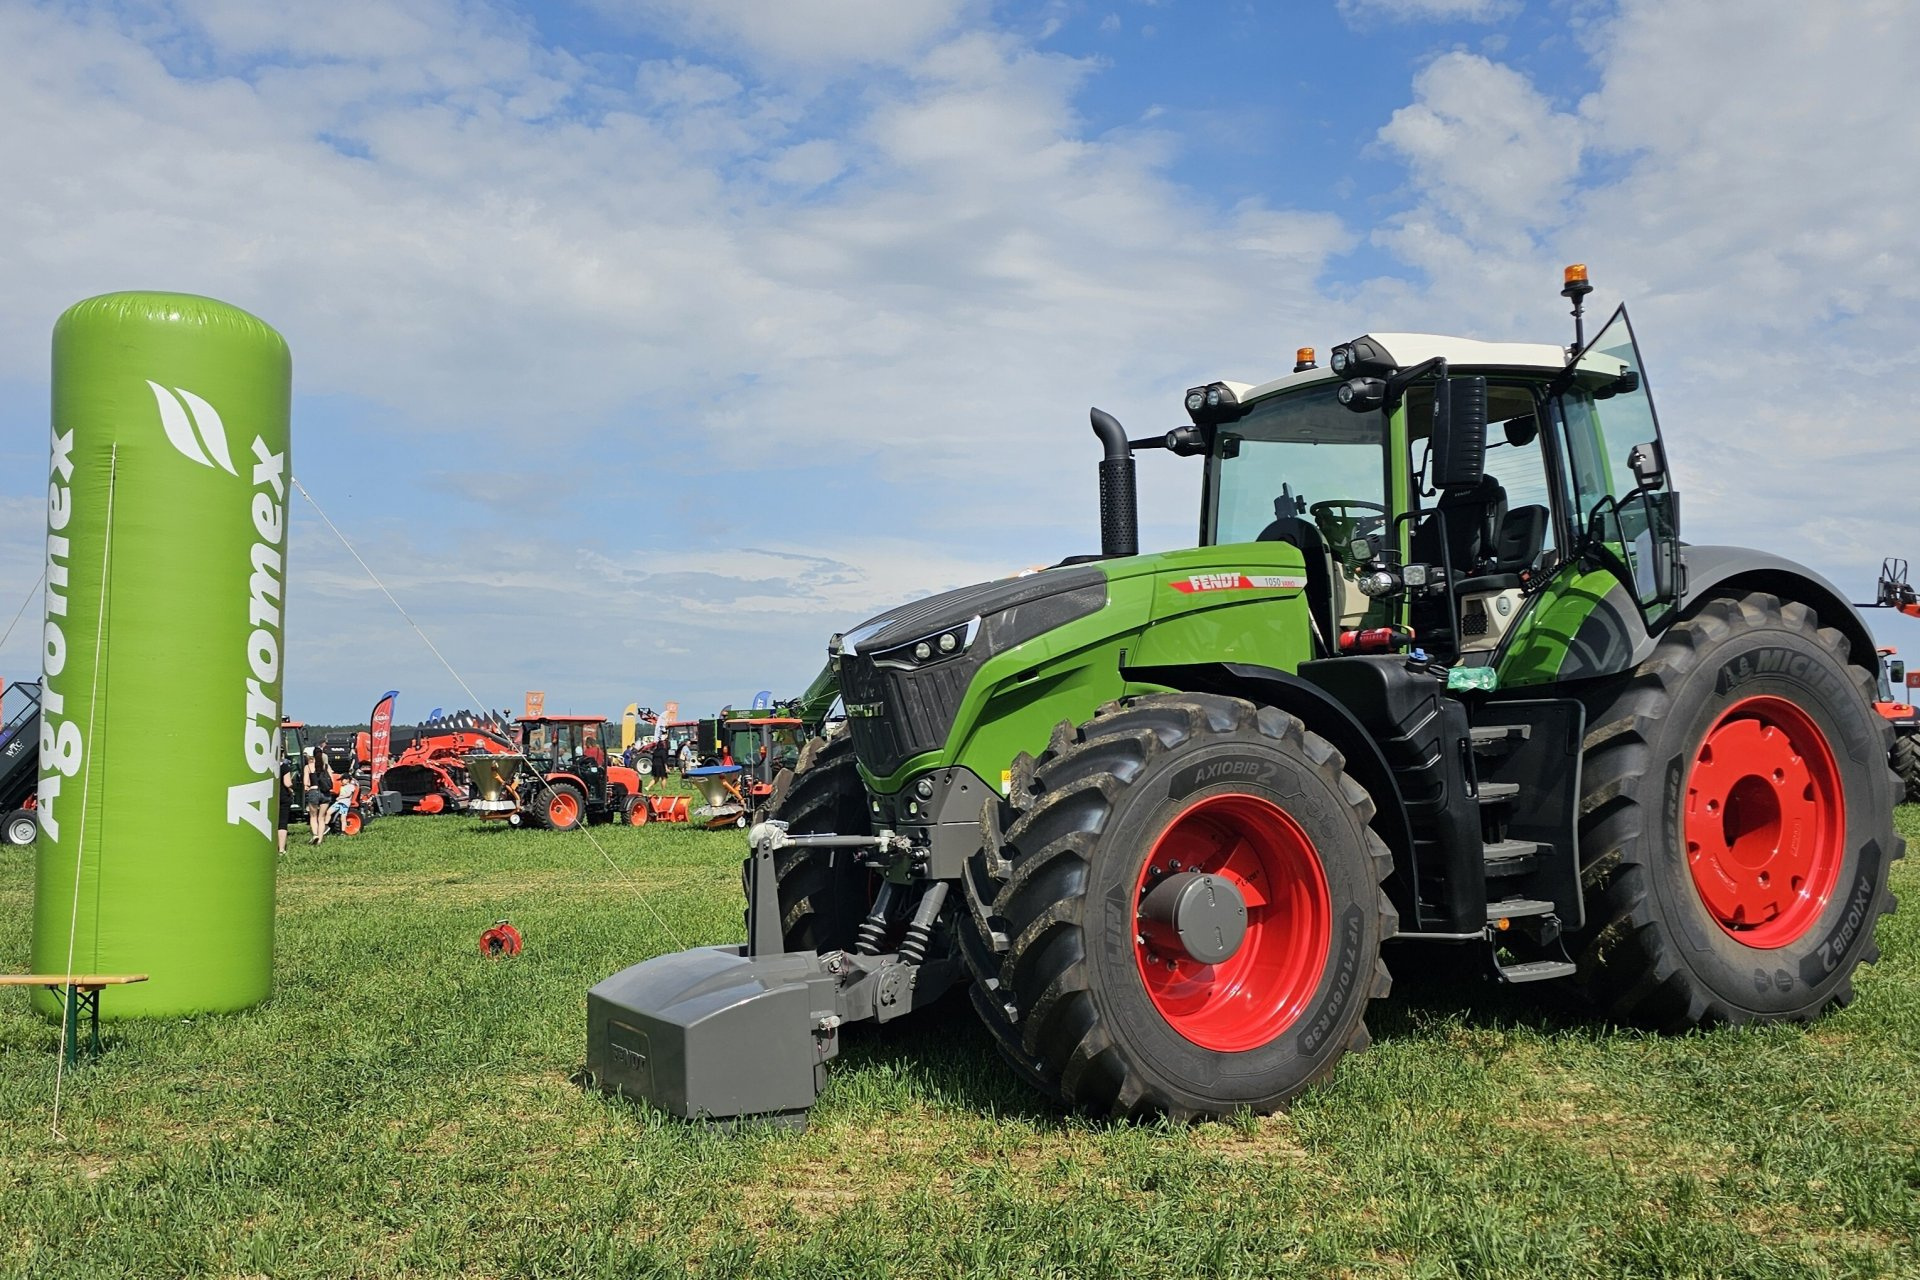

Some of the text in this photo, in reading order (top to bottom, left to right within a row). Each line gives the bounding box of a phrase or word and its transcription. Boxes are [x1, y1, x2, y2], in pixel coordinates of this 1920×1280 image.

[1188, 572, 1241, 591] FENDT
[1264, 577, 1281, 587] 1050
[37, 426, 83, 843] Agromex
[226, 433, 285, 842] Agromex
[1756, 650, 1866, 736] MICHEL
[1194, 761, 1260, 784] AXIOBIB
[1348, 916, 1360, 945] VF
[1832, 876, 1872, 956] AXIOBIB
[1303, 1015, 1332, 1050] R38
